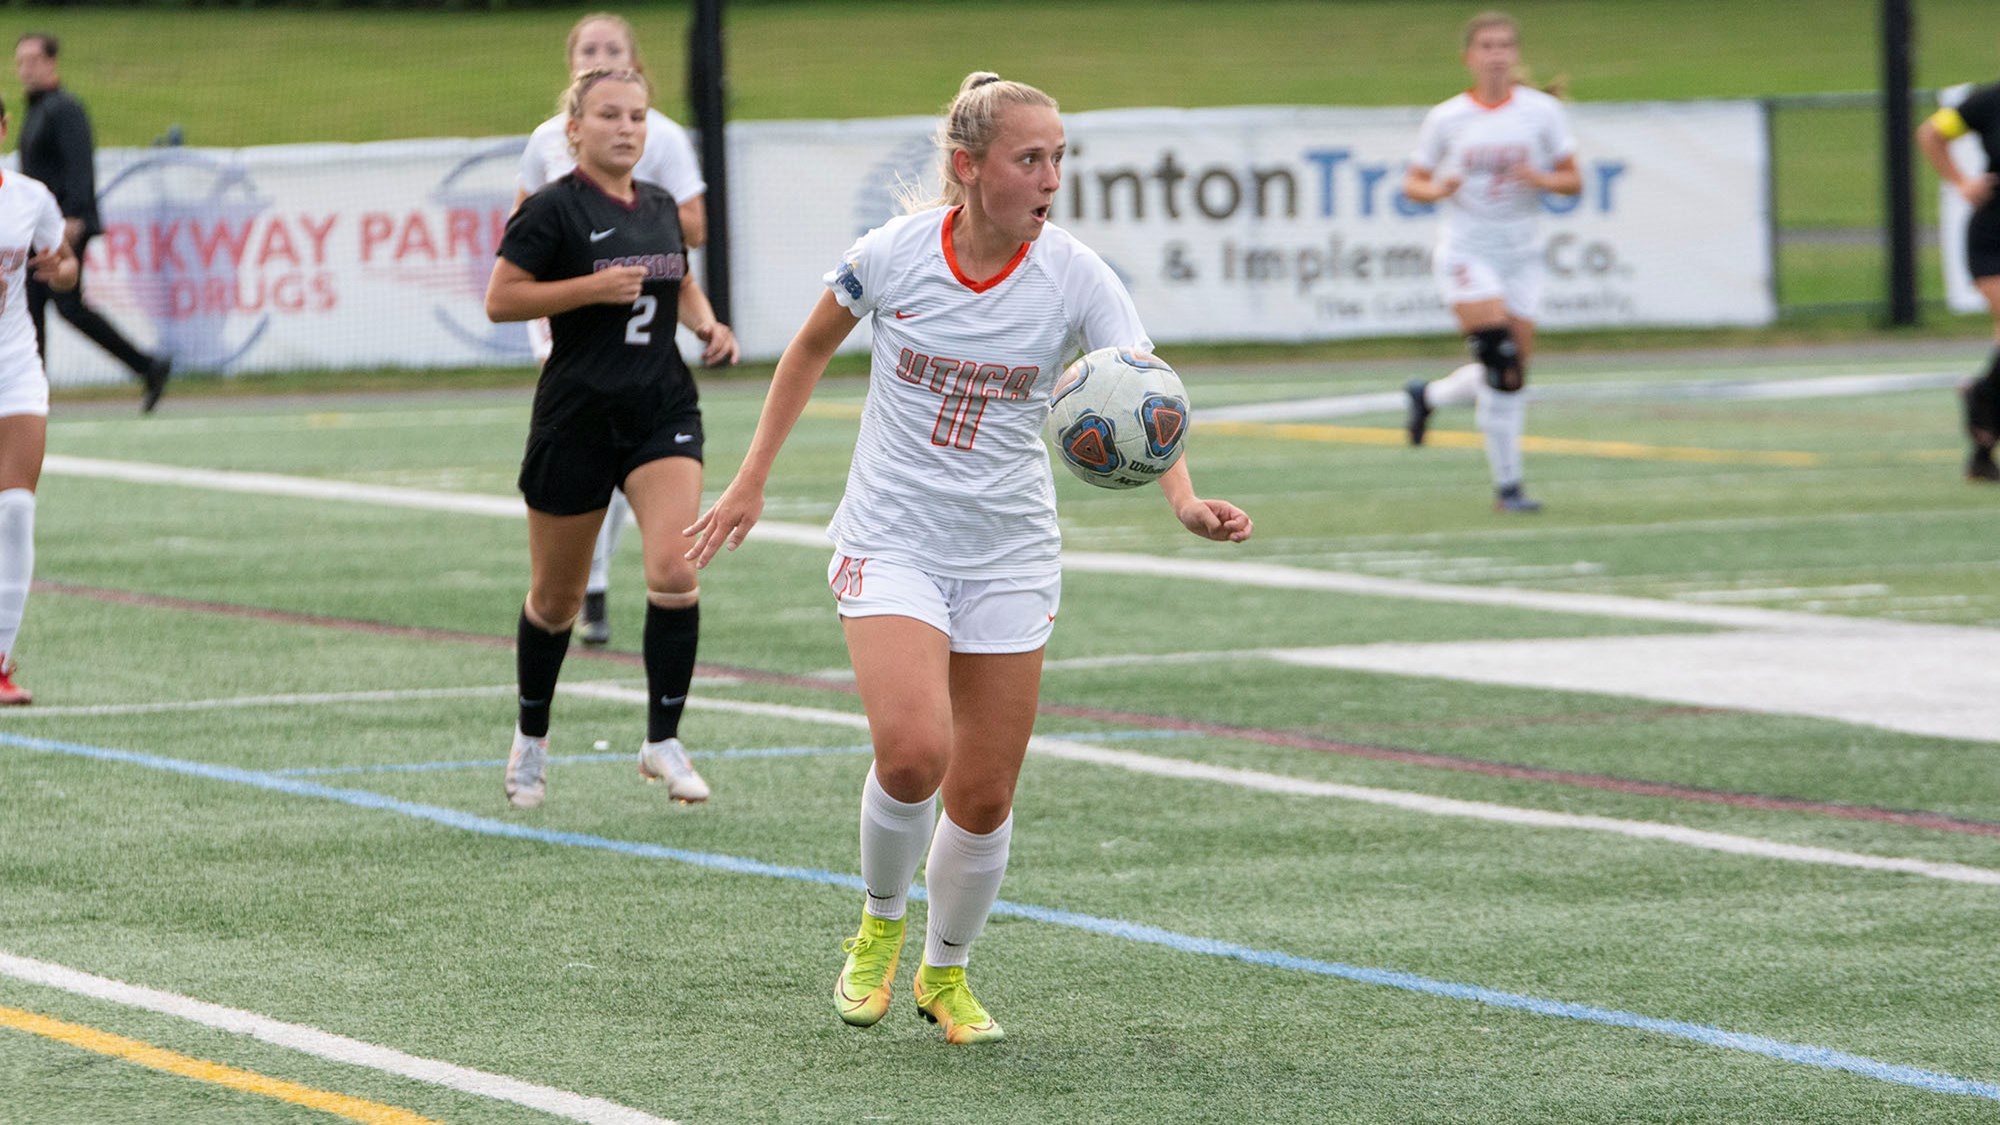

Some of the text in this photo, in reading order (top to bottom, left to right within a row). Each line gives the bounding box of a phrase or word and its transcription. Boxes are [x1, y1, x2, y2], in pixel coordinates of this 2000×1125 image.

[85, 213, 337, 273] RKWAY
[1161, 240, 1197, 281] &
[1221, 231, 1435, 293] Implem
[169, 271, 337, 321] DRUGS
[624, 295, 658, 345] 2
[896, 347, 1039, 401] UTICA
[931, 394, 988, 450] 11
